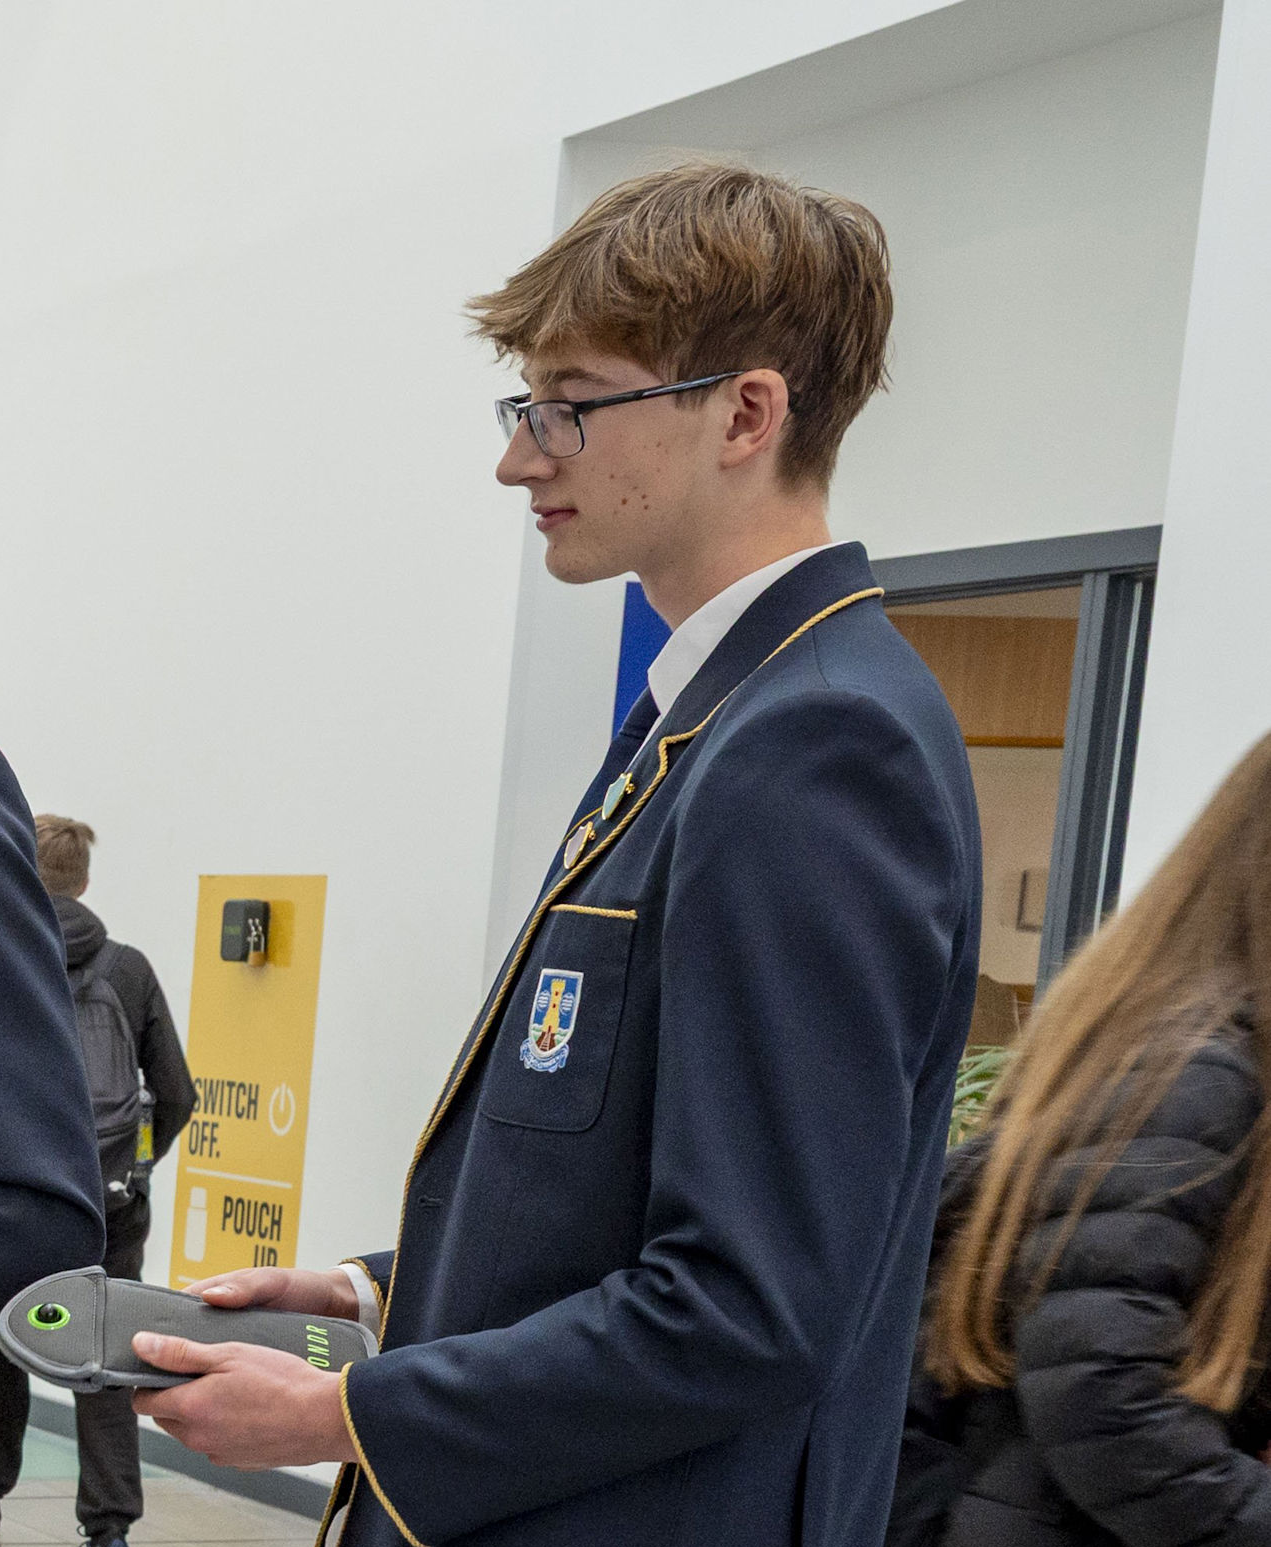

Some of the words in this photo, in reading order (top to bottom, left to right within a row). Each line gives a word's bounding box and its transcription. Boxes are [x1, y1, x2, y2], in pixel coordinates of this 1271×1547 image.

[193, 1078, 259, 1120] SWITCH
[188, 1120, 220, 1158] OFF.
[222, 1196, 283, 1241] POUCH
[306, 1325, 330, 1367] ONDR
